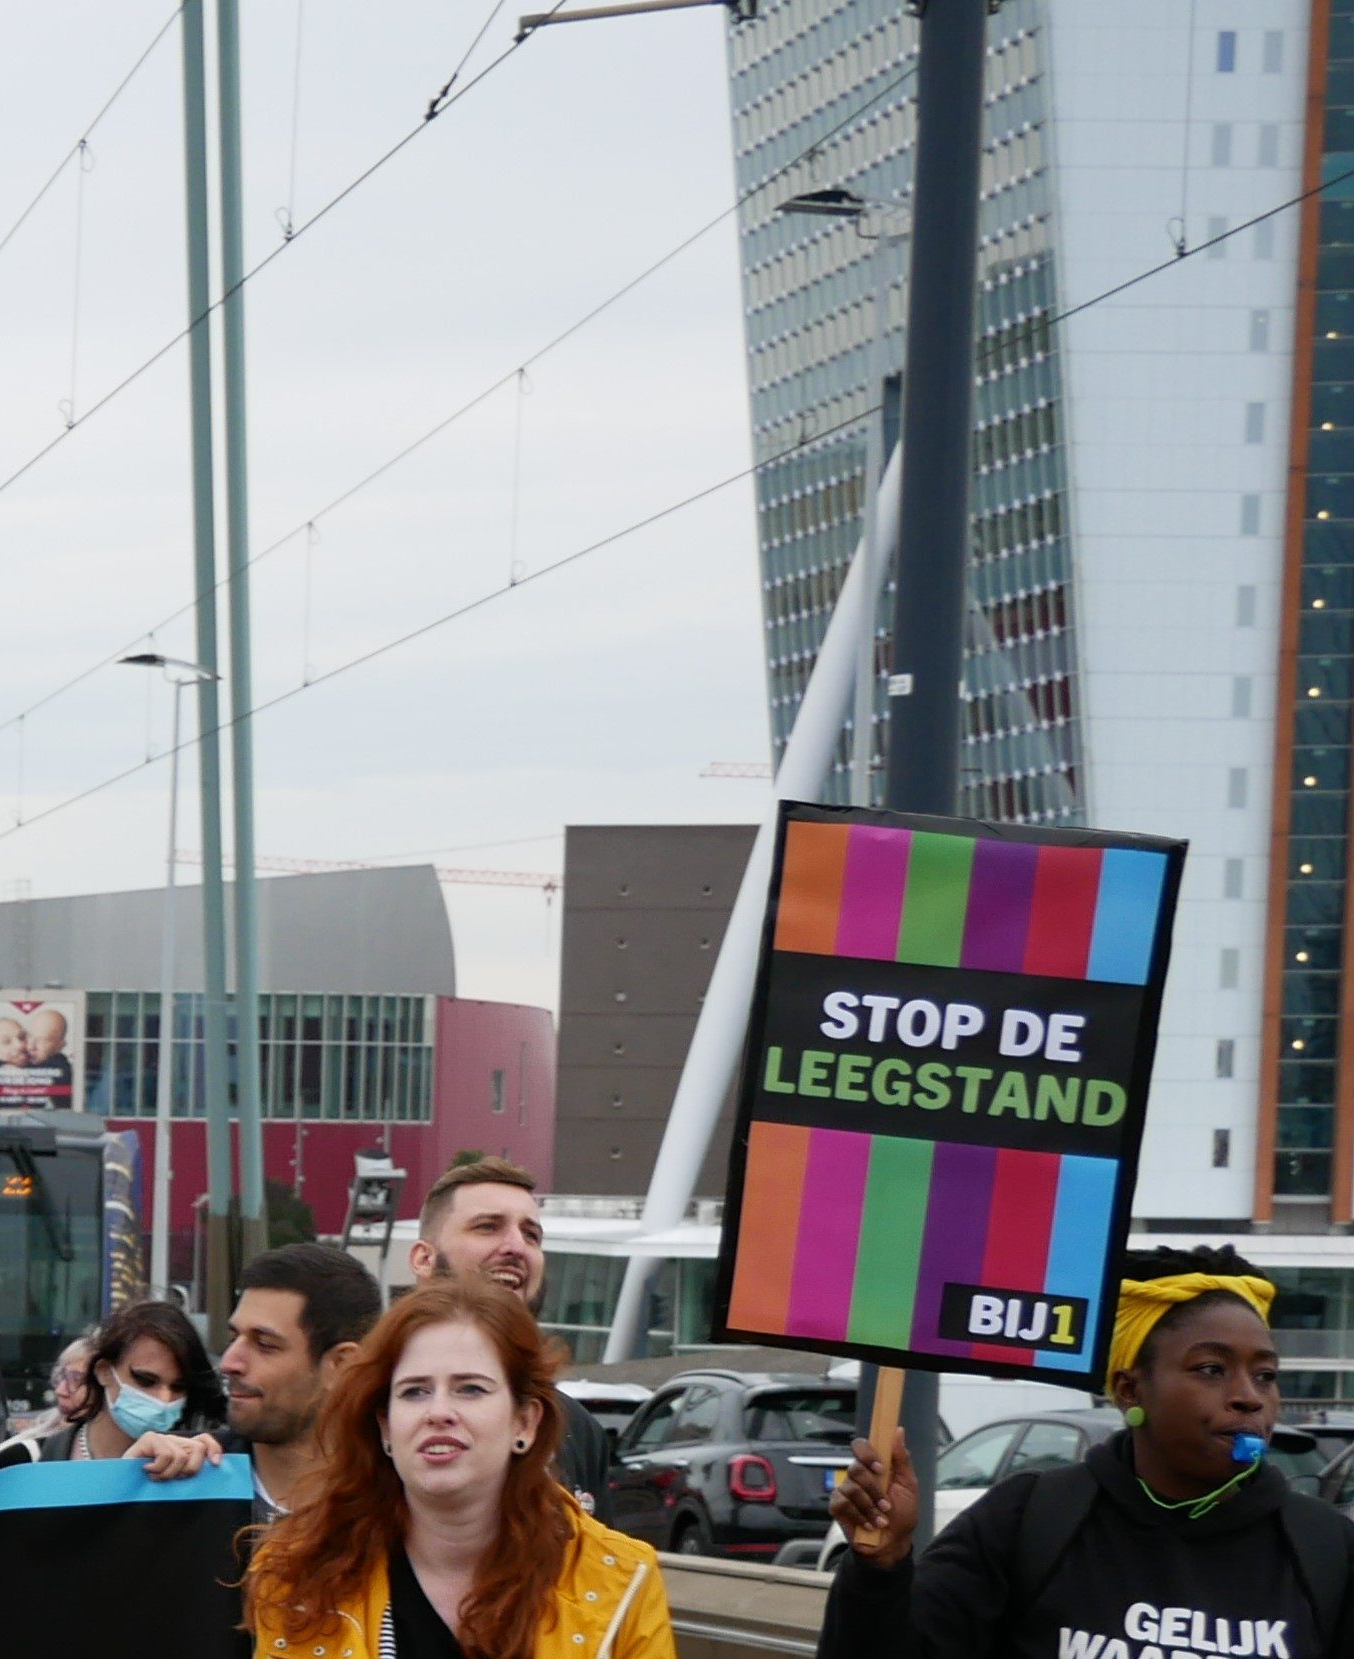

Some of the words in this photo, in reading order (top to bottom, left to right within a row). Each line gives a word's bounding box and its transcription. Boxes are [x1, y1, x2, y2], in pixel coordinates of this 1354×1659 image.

[820, 991, 985, 1050] STOP
[999, 1010, 1087, 1063] DE
[763, 1045, 1129, 1128] LEEGSTAND
[968, 1295, 1076, 1345] BIJ1
